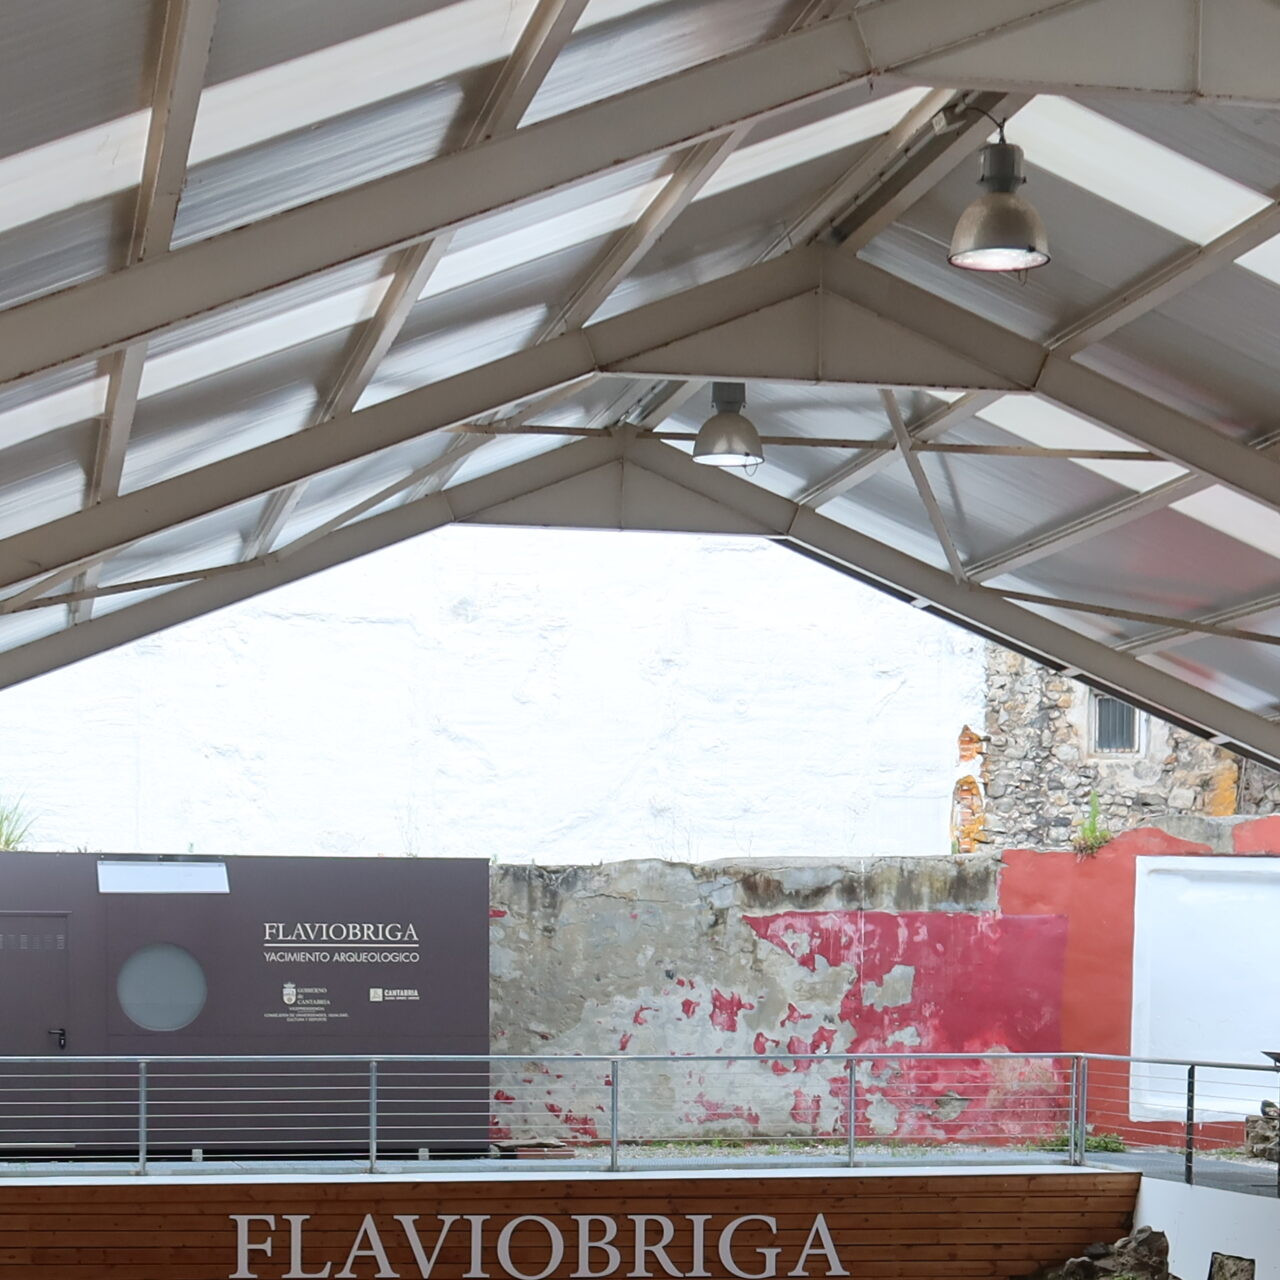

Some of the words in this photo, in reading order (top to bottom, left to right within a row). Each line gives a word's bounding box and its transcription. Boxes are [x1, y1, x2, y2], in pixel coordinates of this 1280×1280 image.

[263, 922, 420, 941] FLAVIOBRIGA
[263, 951, 331, 963] YACIMIENTO
[332, 951, 420, 963] ARQUEOLOGICO
[228, 1212, 851, 1280] FLAVIOBRIGA
